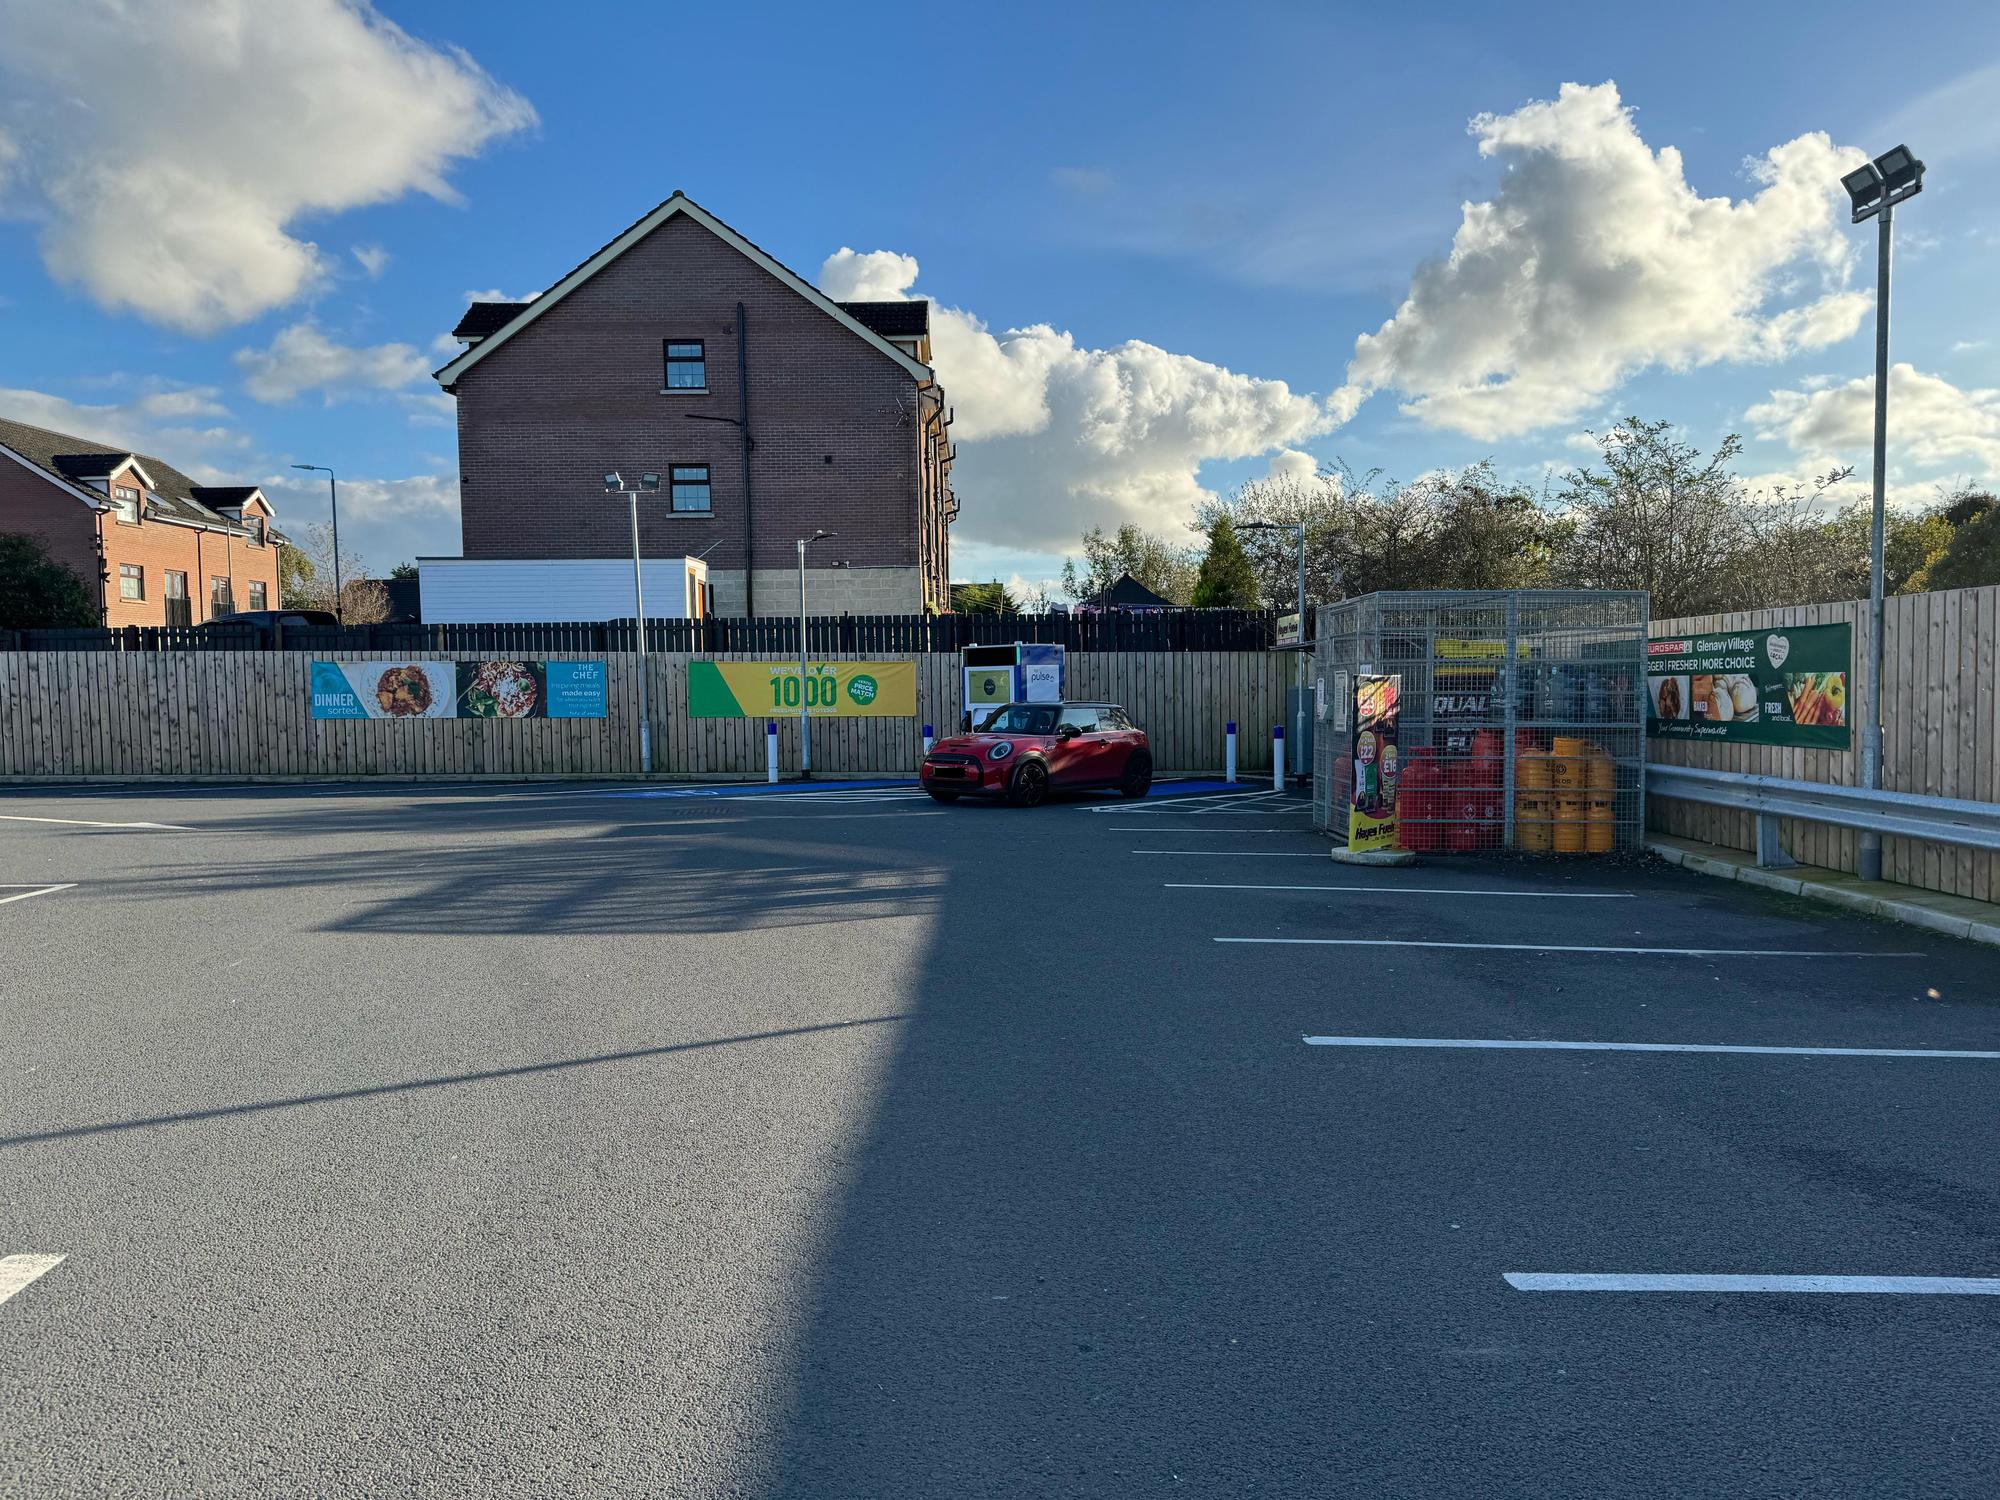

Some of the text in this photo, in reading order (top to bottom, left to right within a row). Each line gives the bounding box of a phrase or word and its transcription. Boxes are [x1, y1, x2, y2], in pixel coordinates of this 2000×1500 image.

[1697, 640, 1727, 653] Glenavy
[1728, 637, 1754, 652] Village
[1668, 660, 1698, 670] FRESHER
[1702, 658, 1723, 669] MORE
[1725, 657, 1755, 669] CHOICE
[1031, 672, 1050, 683] pulse
[584, 690, 601, 698] easy
[770, 676, 837, 707] 1000
[850, 688, 875, 698] MATCH
[854, 683, 874, 692] PRICE
[314, 693, 354, 707] DINNER
[1765, 702, 1781, 713] FRESH
[1694, 723, 1728, 737] Supermarket
[1355, 826, 1378, 840] Hayes
